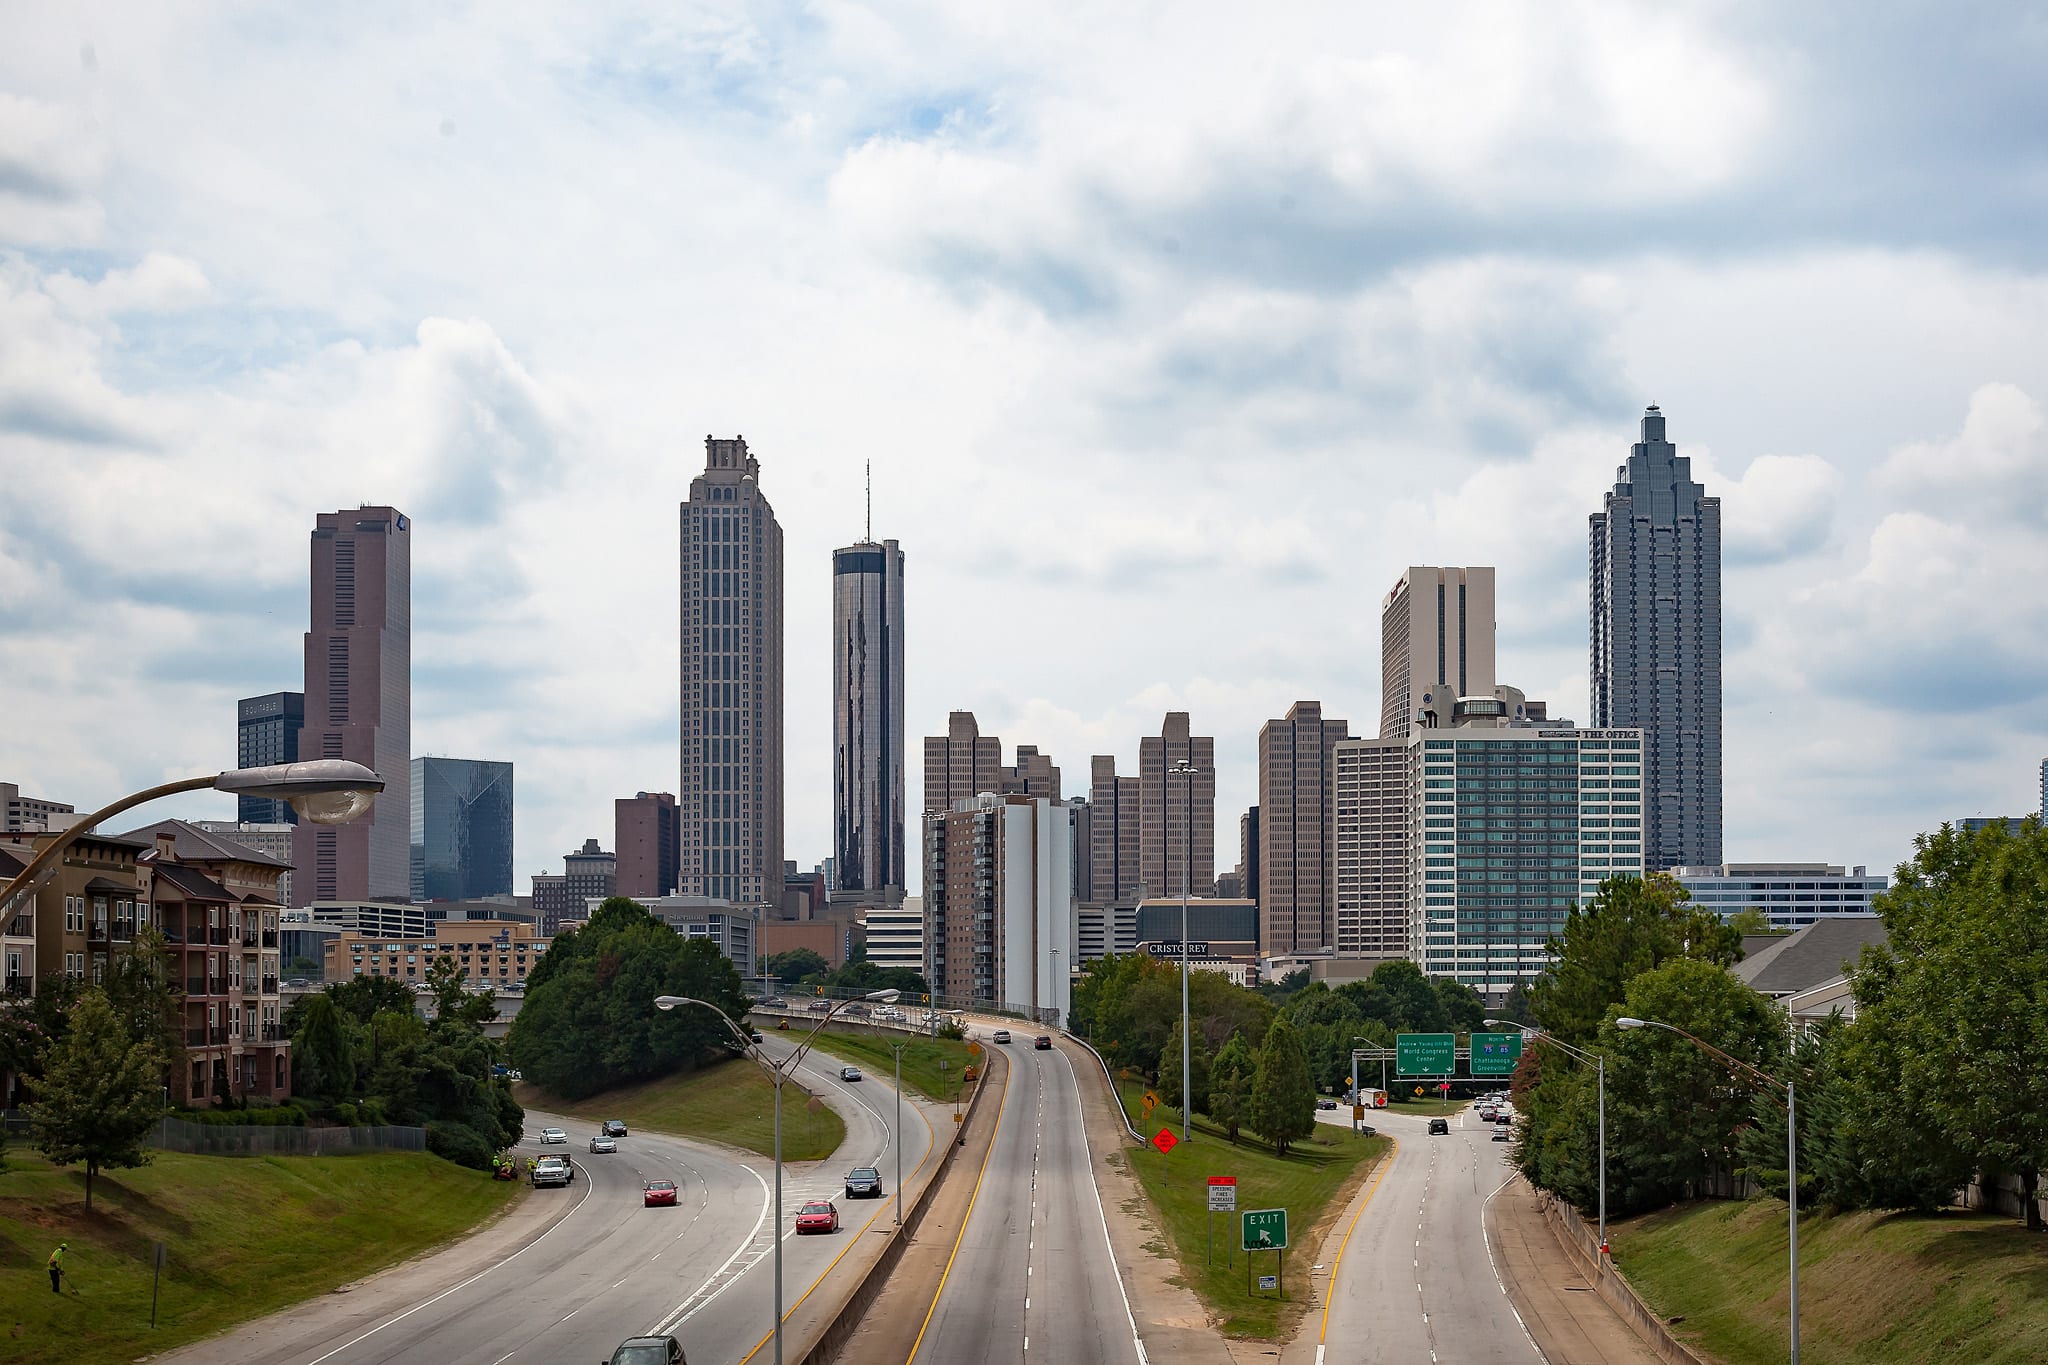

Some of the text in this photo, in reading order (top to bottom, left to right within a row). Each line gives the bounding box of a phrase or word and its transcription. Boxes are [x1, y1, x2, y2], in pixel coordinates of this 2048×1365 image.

[245, 702, 277, 715] EQUITABLE
[1606, 730, 1640, 739] OFFICE
[1149, 944, 1207, 953] CRISTO REY
[1250, 1214, 1279, 1224] EXIT
